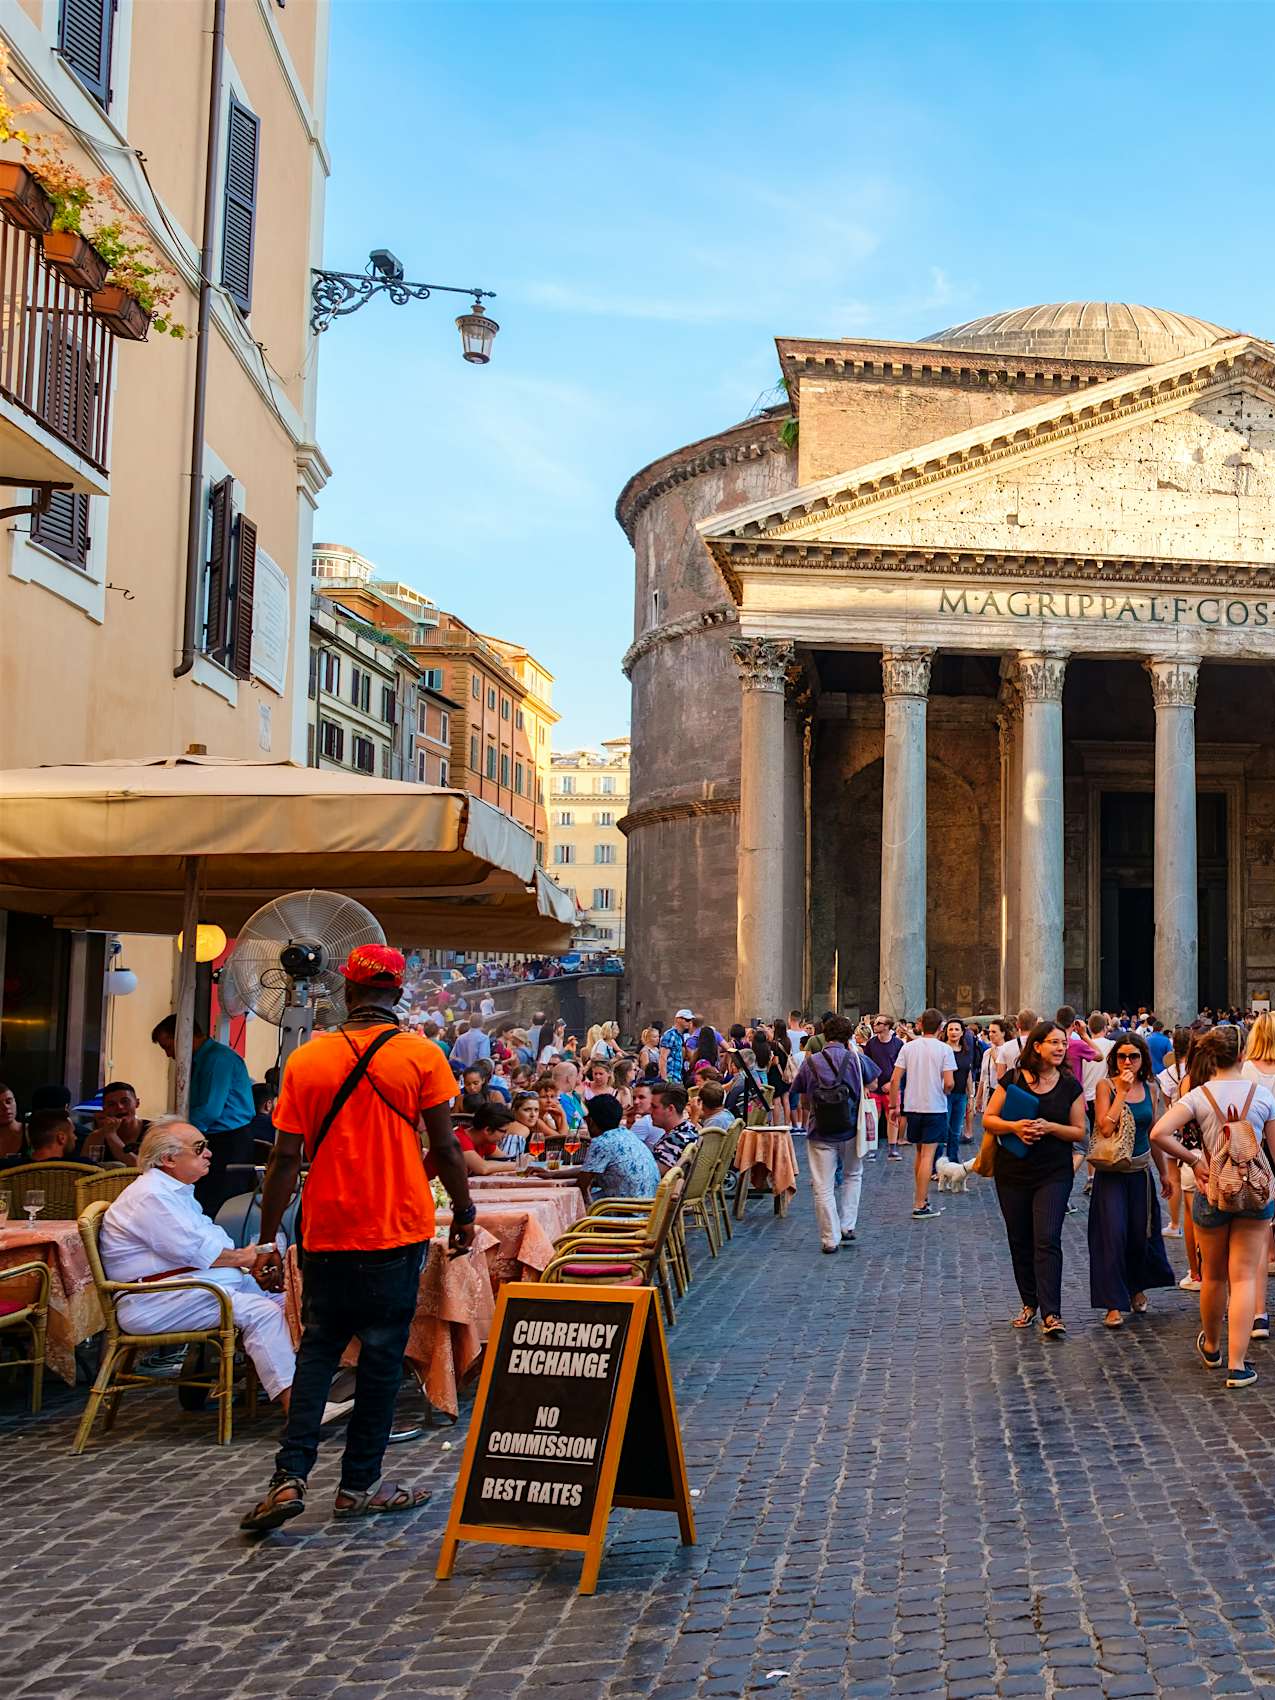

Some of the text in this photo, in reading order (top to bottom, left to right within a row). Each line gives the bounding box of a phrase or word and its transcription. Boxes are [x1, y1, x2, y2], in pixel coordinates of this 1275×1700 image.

[512, 1320, 618, 1348] CURRENCY
[508, 1349, 610, 1378] EXCHANGE
[535, 1406, 560, 1428] NO
[488, 1431, 597, 1459] COMMISSION
[481, 1477, 582, 1506] BEST RATES
